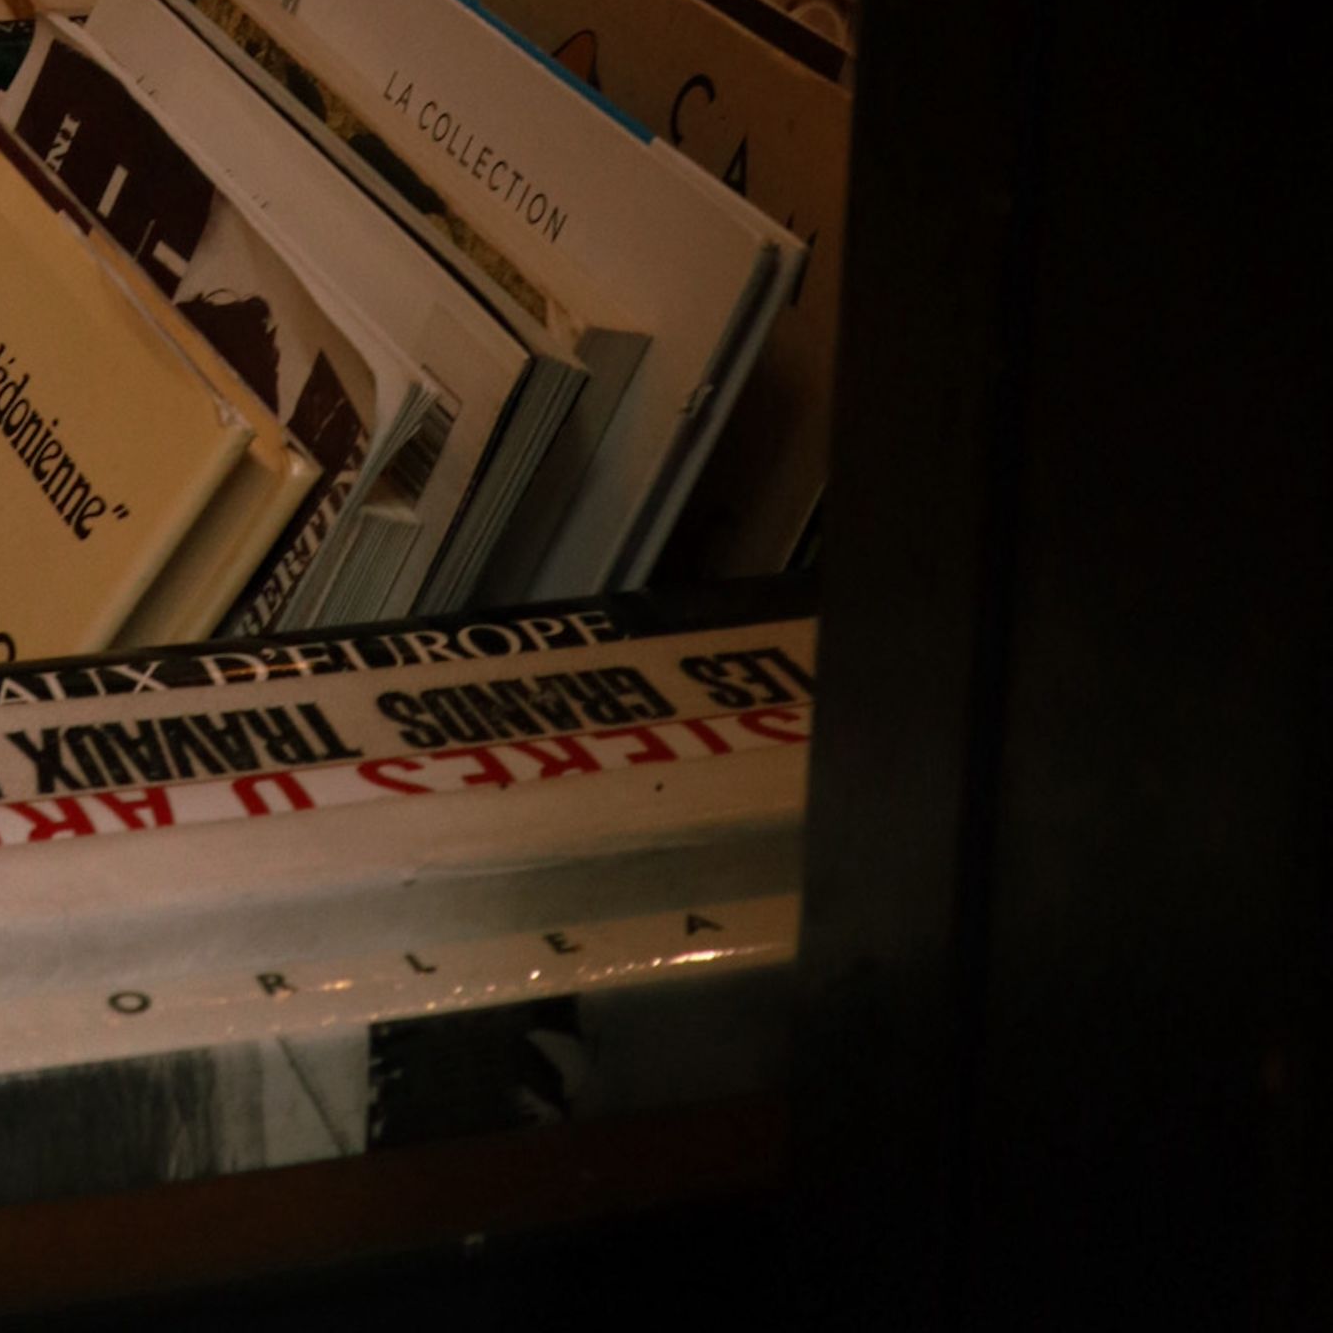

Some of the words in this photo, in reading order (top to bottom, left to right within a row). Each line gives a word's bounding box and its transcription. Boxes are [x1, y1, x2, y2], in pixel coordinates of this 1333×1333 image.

[382, 70, 414, 113] LA
[419, 100, 569, 244] COLLECTION
[192, 609, 618, 683] D'EUROPE
[679, 645, 814, 709] LES
[5, 700, 361, 794] TRAVAUX
[377, 666, 676, 750] GRANDS
